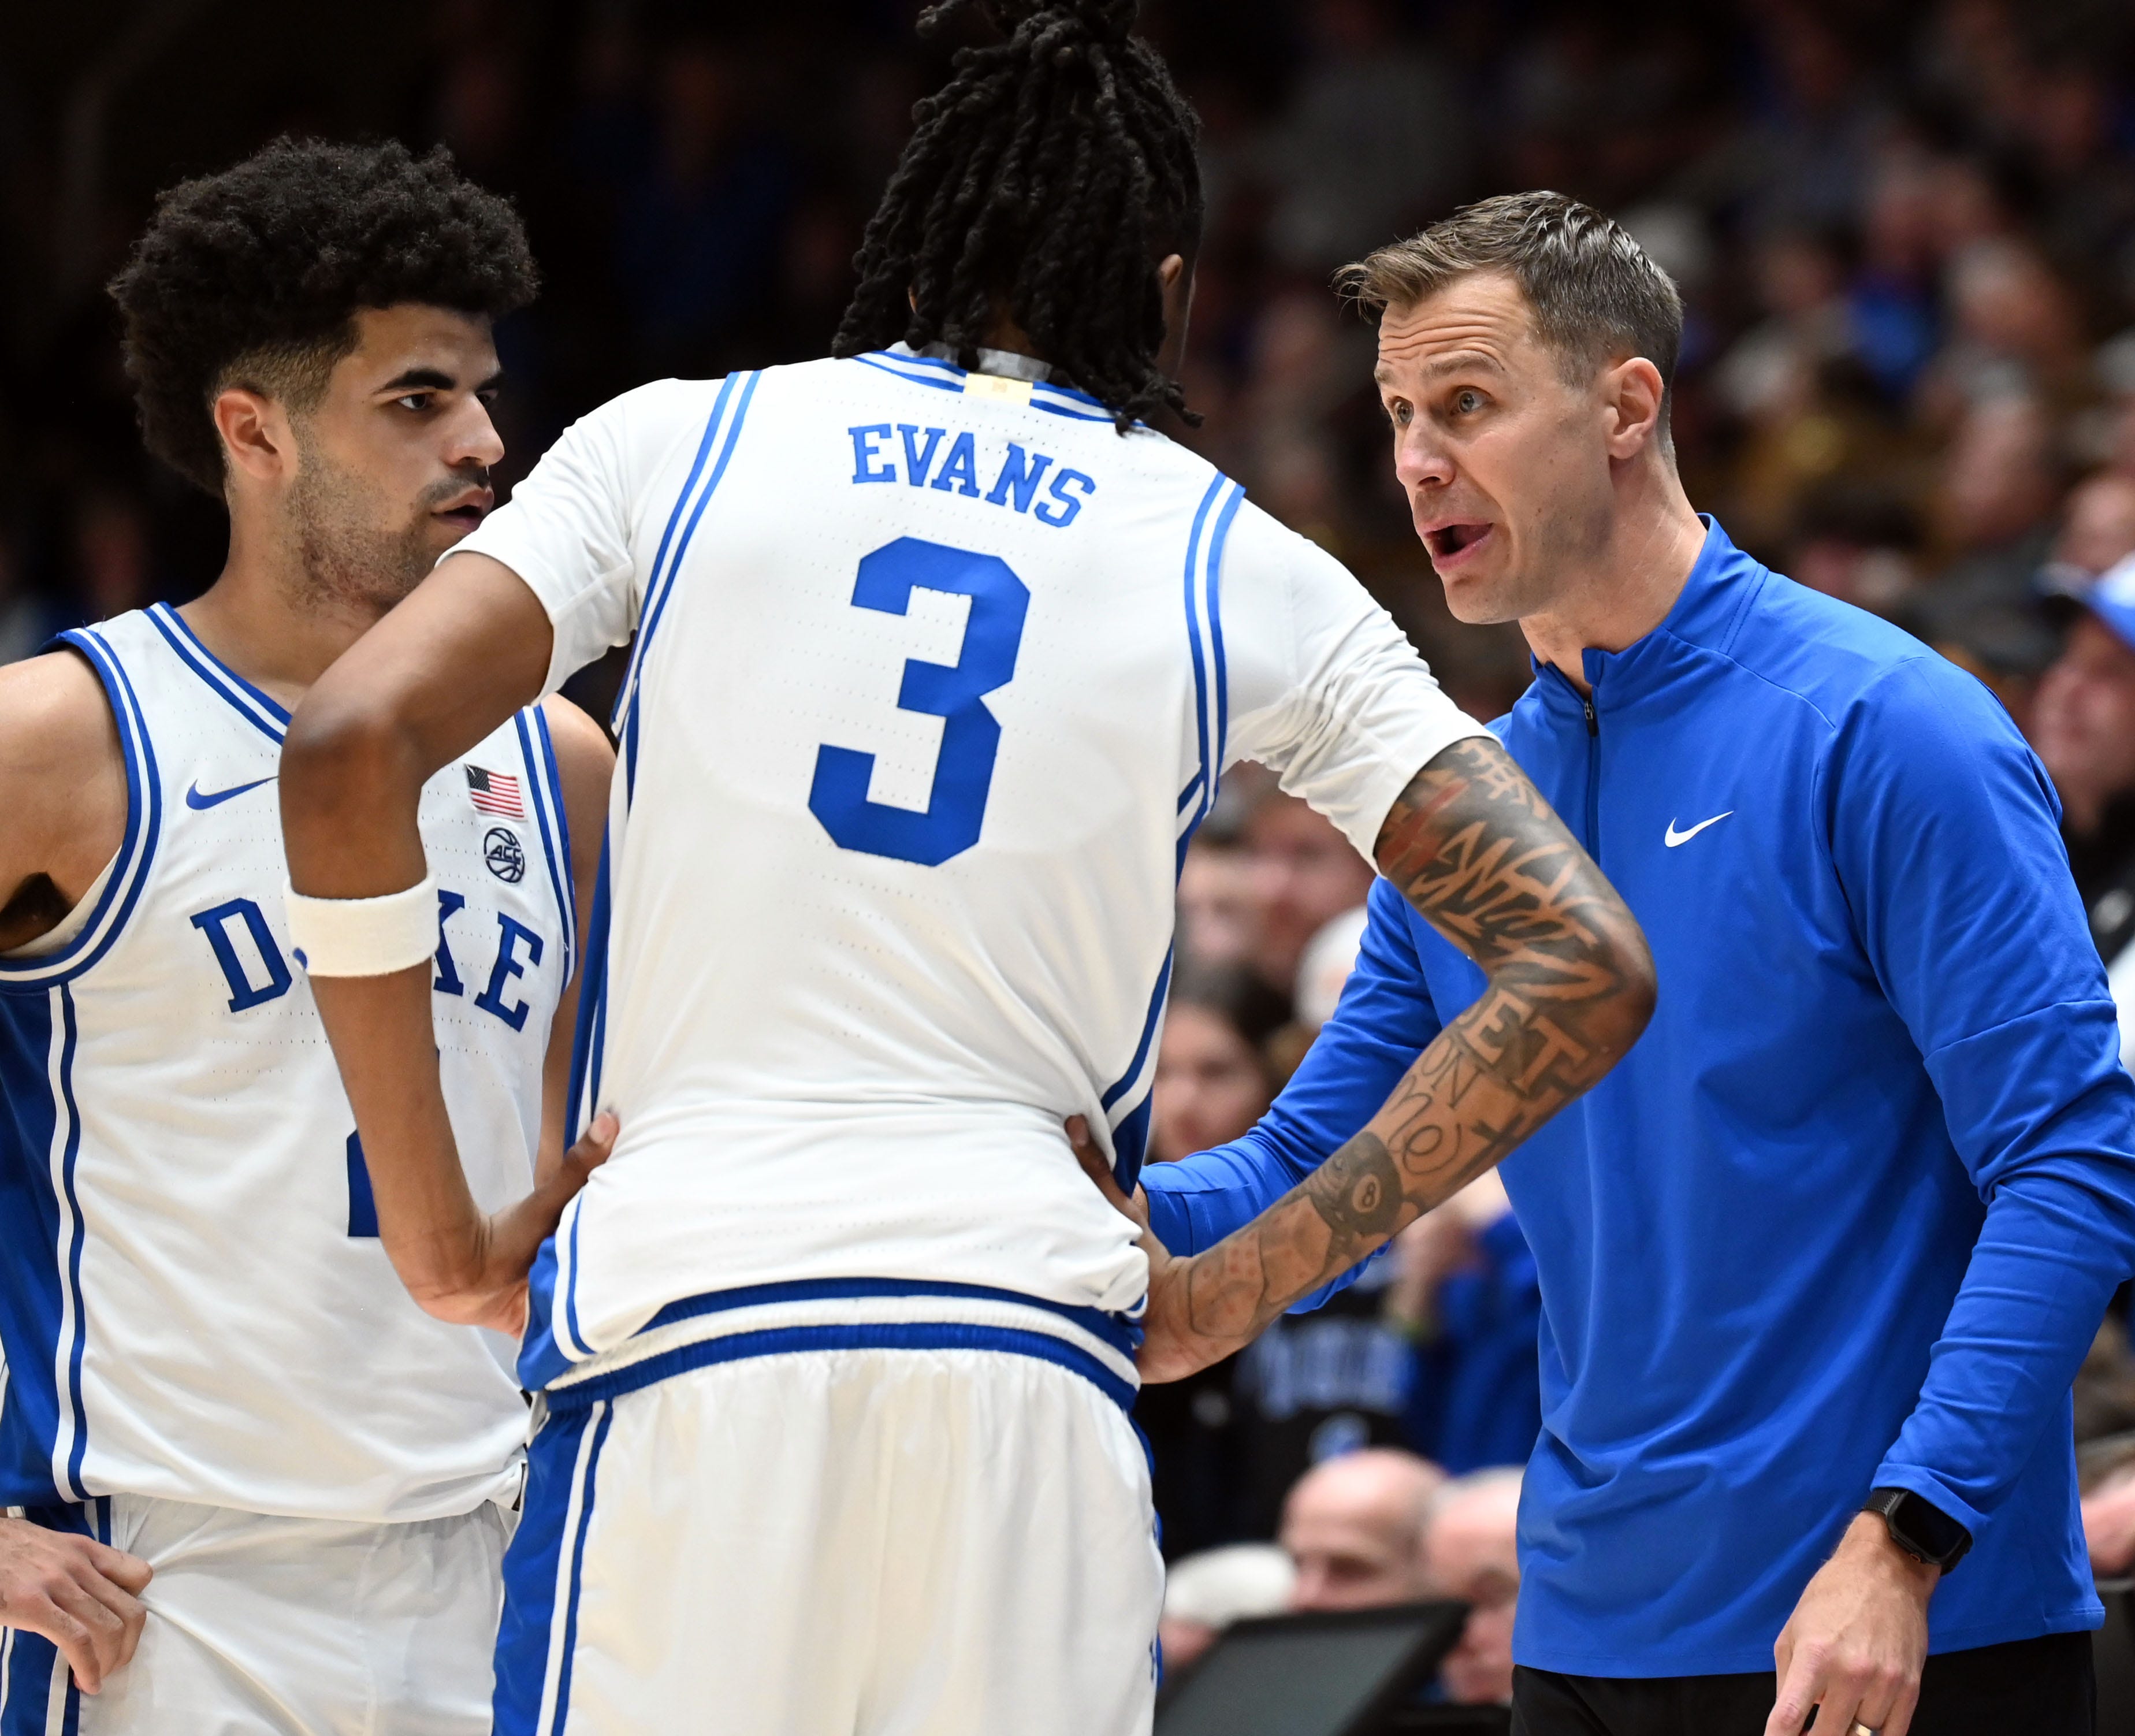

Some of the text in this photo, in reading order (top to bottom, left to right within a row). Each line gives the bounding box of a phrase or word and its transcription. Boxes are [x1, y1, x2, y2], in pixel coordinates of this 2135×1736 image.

[848, 423, 1096, 528] EVANS
[809, 536, 1031, 867] 3
[490, 844, 522, 866] ACC
[189, 890, 544, 1033] DKE
[1456, 988, 1590, 1095] ET
[1361, 1180, 1378, 1207] 8
